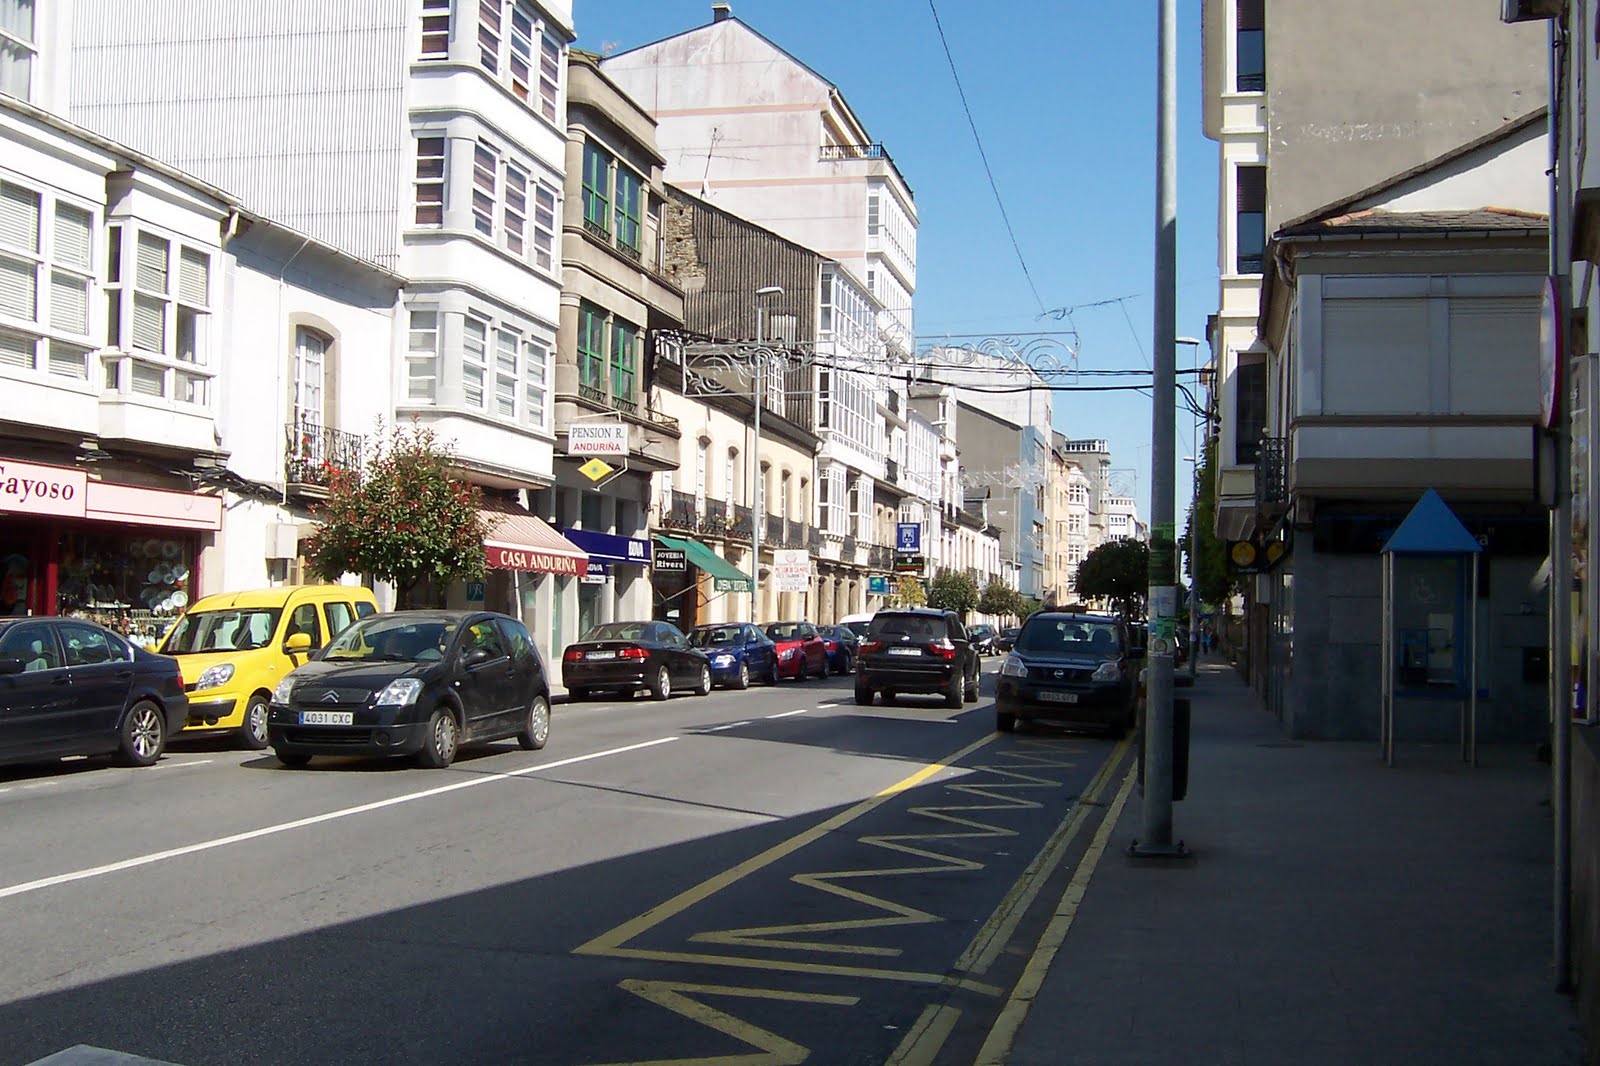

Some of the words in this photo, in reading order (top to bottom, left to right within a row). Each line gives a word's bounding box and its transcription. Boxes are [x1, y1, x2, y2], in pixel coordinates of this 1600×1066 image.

[572, 427, 611, 438] PENSION
[573, 442, 621, 451] ANDURIÑA
[500, 550, 527, 568] CASA
[530, 554, 577, 573] ANDURIÑA
[305, 713, 328, 723] 4031
[332, 714, 351, 724] CXC
